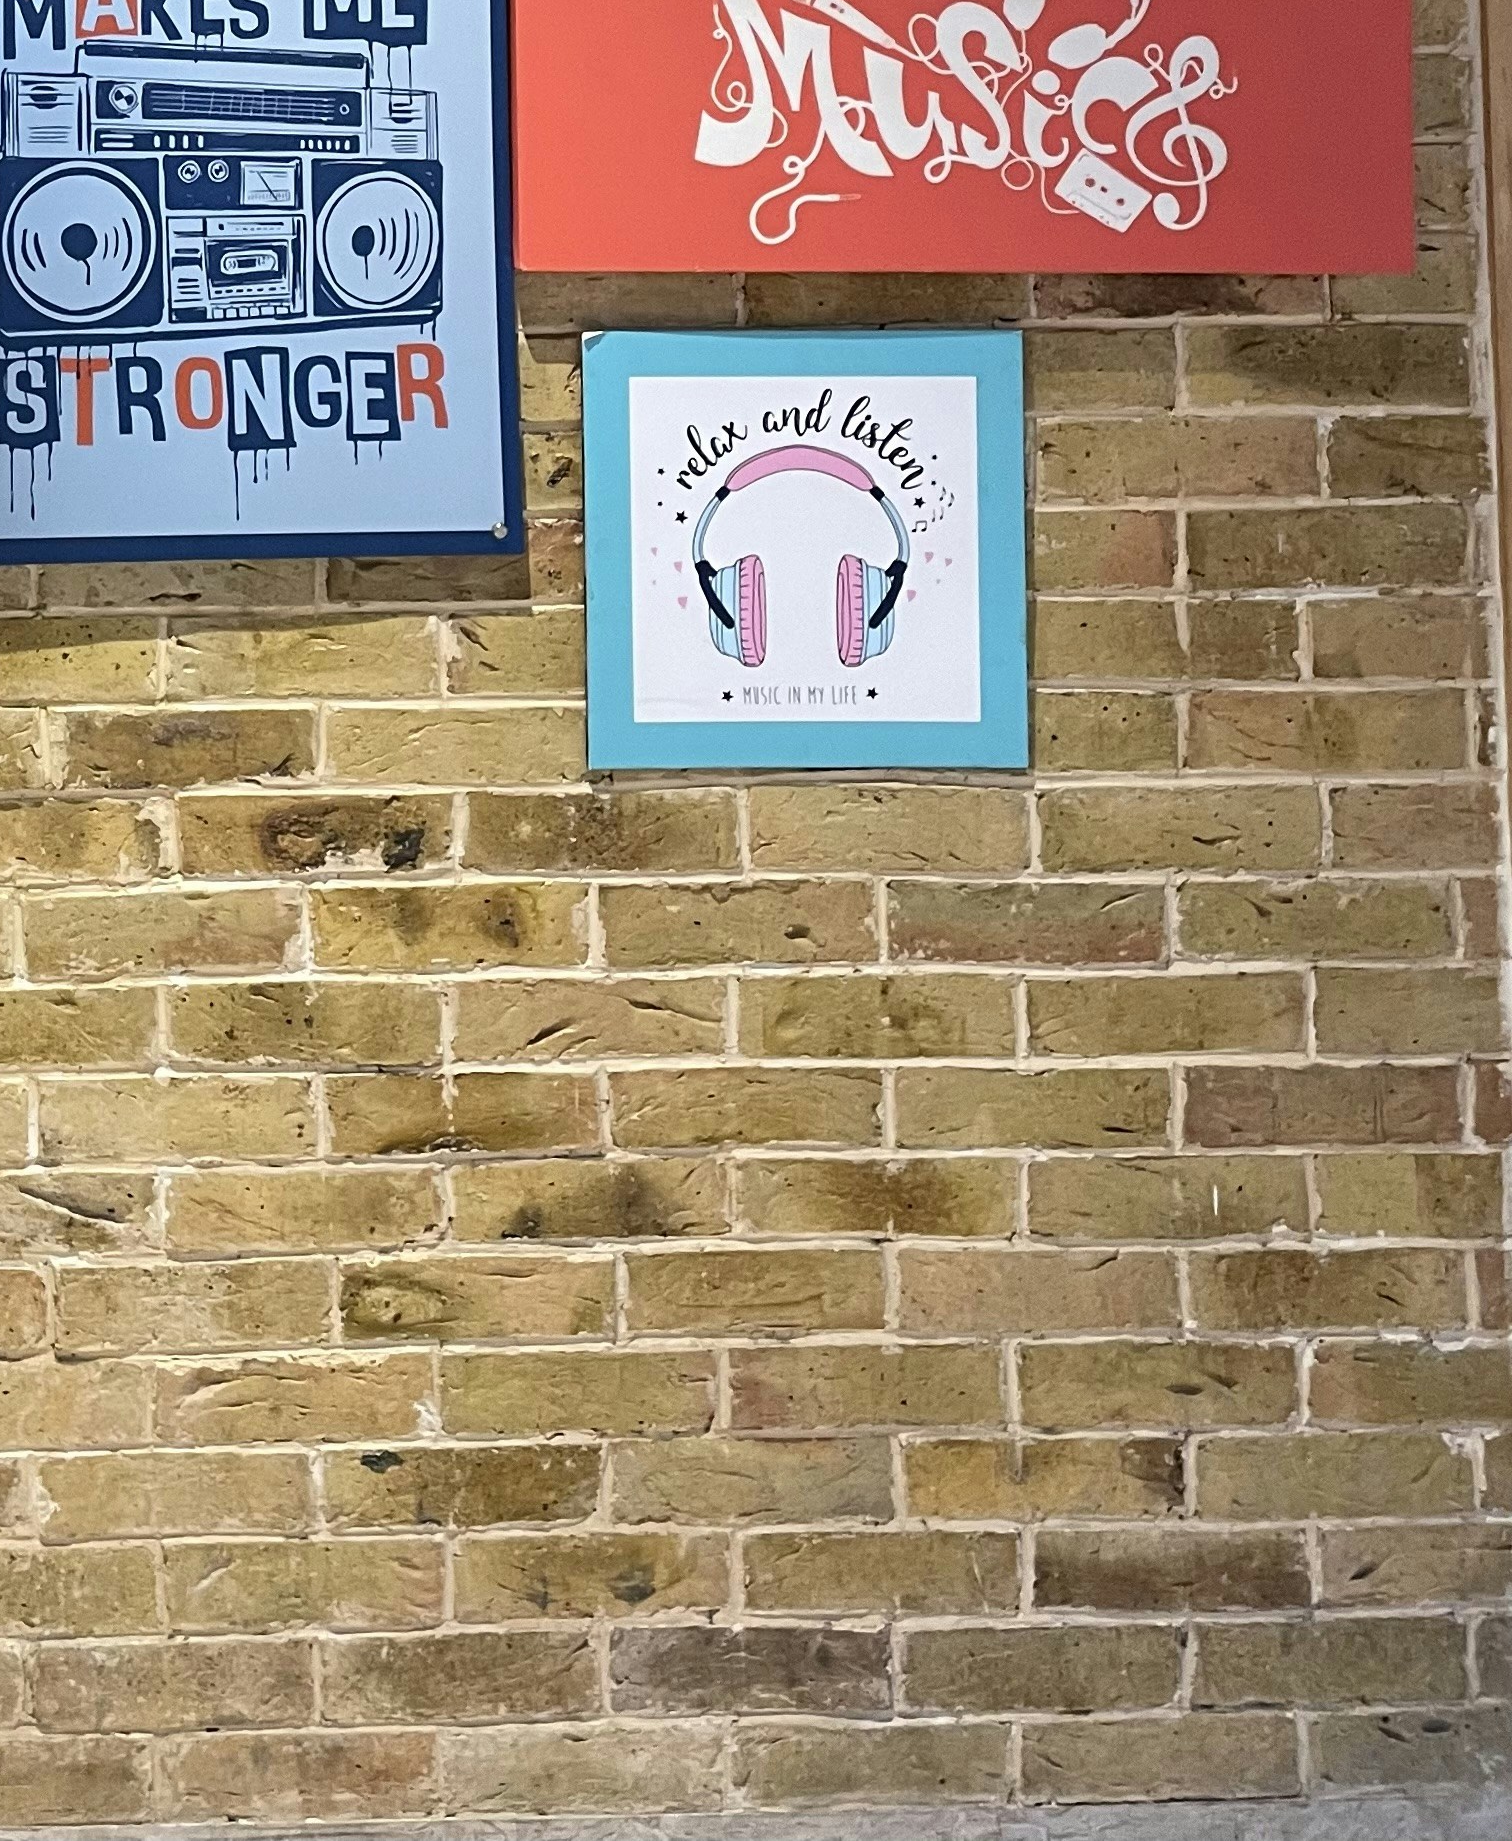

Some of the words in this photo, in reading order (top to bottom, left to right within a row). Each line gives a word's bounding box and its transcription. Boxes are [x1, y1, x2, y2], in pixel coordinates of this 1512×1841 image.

[0, 344, 450, 449] STRONGER
[676, 421, 748, 490] relax
[762, 388, 833, 437] and
[840, 395, 924, 490] listen
[742, 685, 781, 705] MUSIC
[788, 685, 802, 705] IN
[807, 685, 825, 705] MY
[831, 685, 858, 705] LIFE
